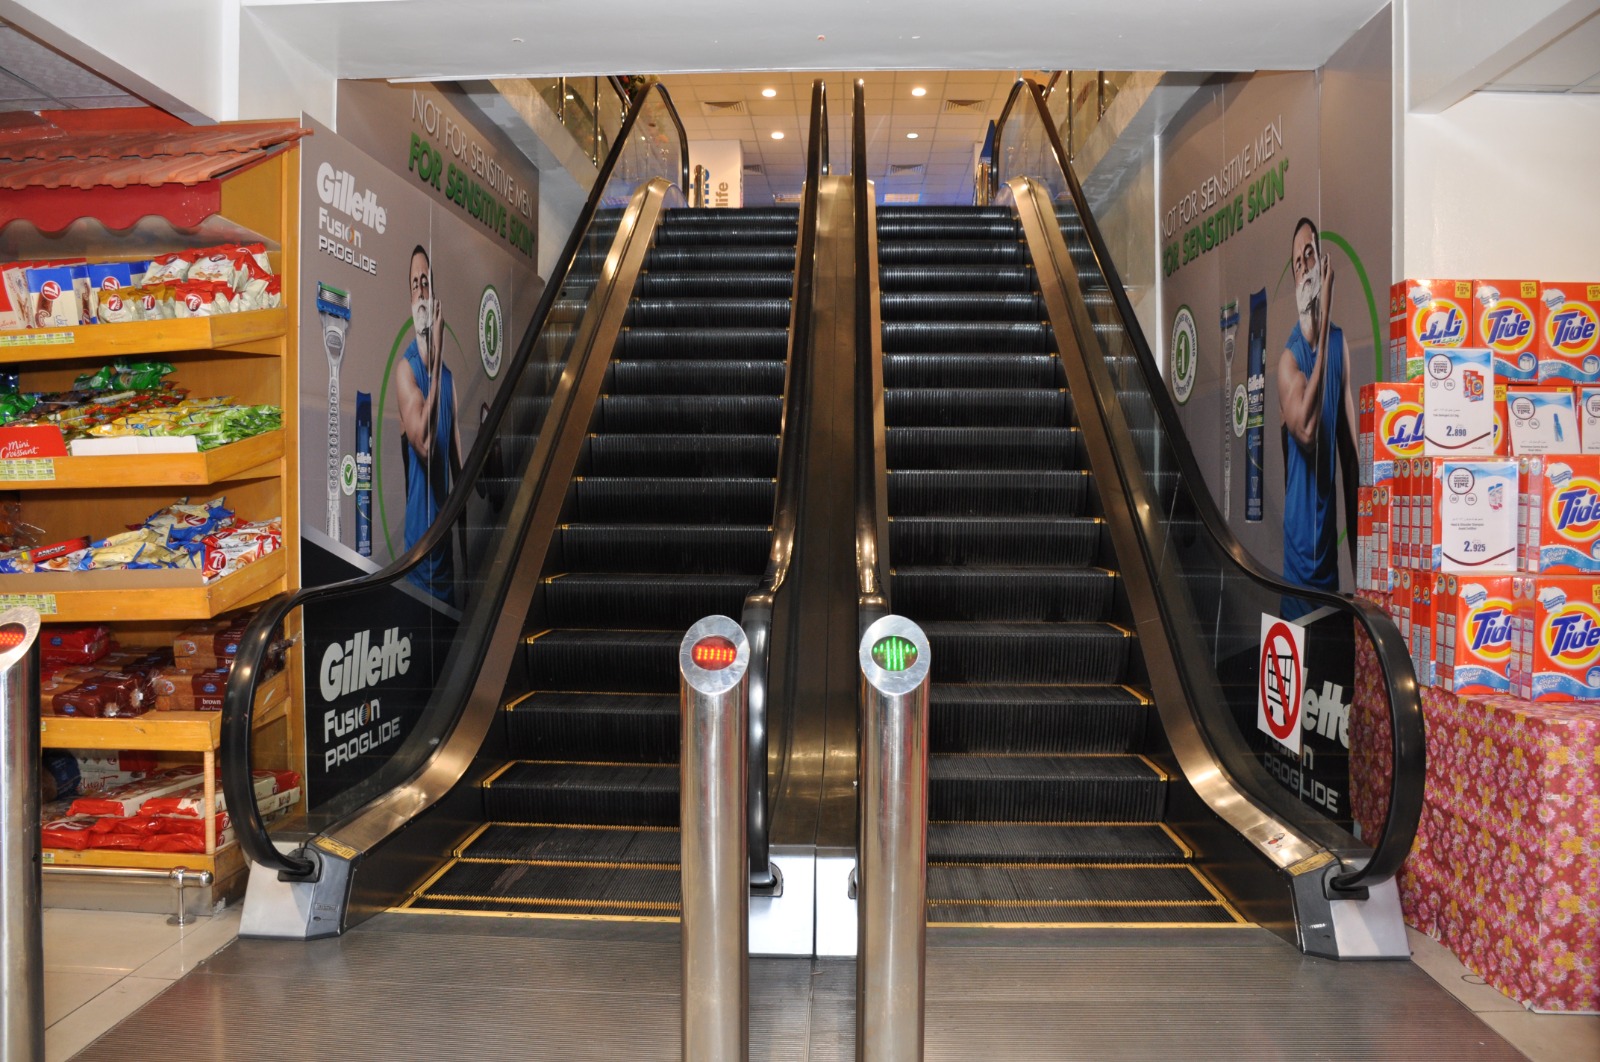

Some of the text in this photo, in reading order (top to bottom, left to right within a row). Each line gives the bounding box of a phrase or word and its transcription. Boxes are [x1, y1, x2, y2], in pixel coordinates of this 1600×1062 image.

[412, 89, 533, 219] NOT FOR SENSITIVE MEN
[316, 161, 388, 234] Gillette
[408, 131, 443, 191] FOR
[445, 162, 507, 238] SENSITIVE
[1161, 114, 1283, 240] NOT FOR SENSITIVE MEN
[1182, 193, 1244, 265] SENSITIVE
[318, 234, 377, 276] PROGLIDE
[1487, 308, 1531, 345] Tide
[1552, 311, 1596, 348] Tide
[0, 446, 40, 458] Croissant
[8, 440, 30, 450] Mini
[1446, 425, 1467, 437] 2.890
[1557, 488, 1600, 531] Tide
[1463, 540, 1486, 552] 2.925
[1471, 609, 1511, 651] Tid
[1549, 614, 1600, 657] Tide
[319, 626, 412, 702] Gillette
[1302, 667, 1351, 750] ette
[325, 715, 402, 773] PROGLIDE
[1264, 751, 1340, 814] PROGLIDE
